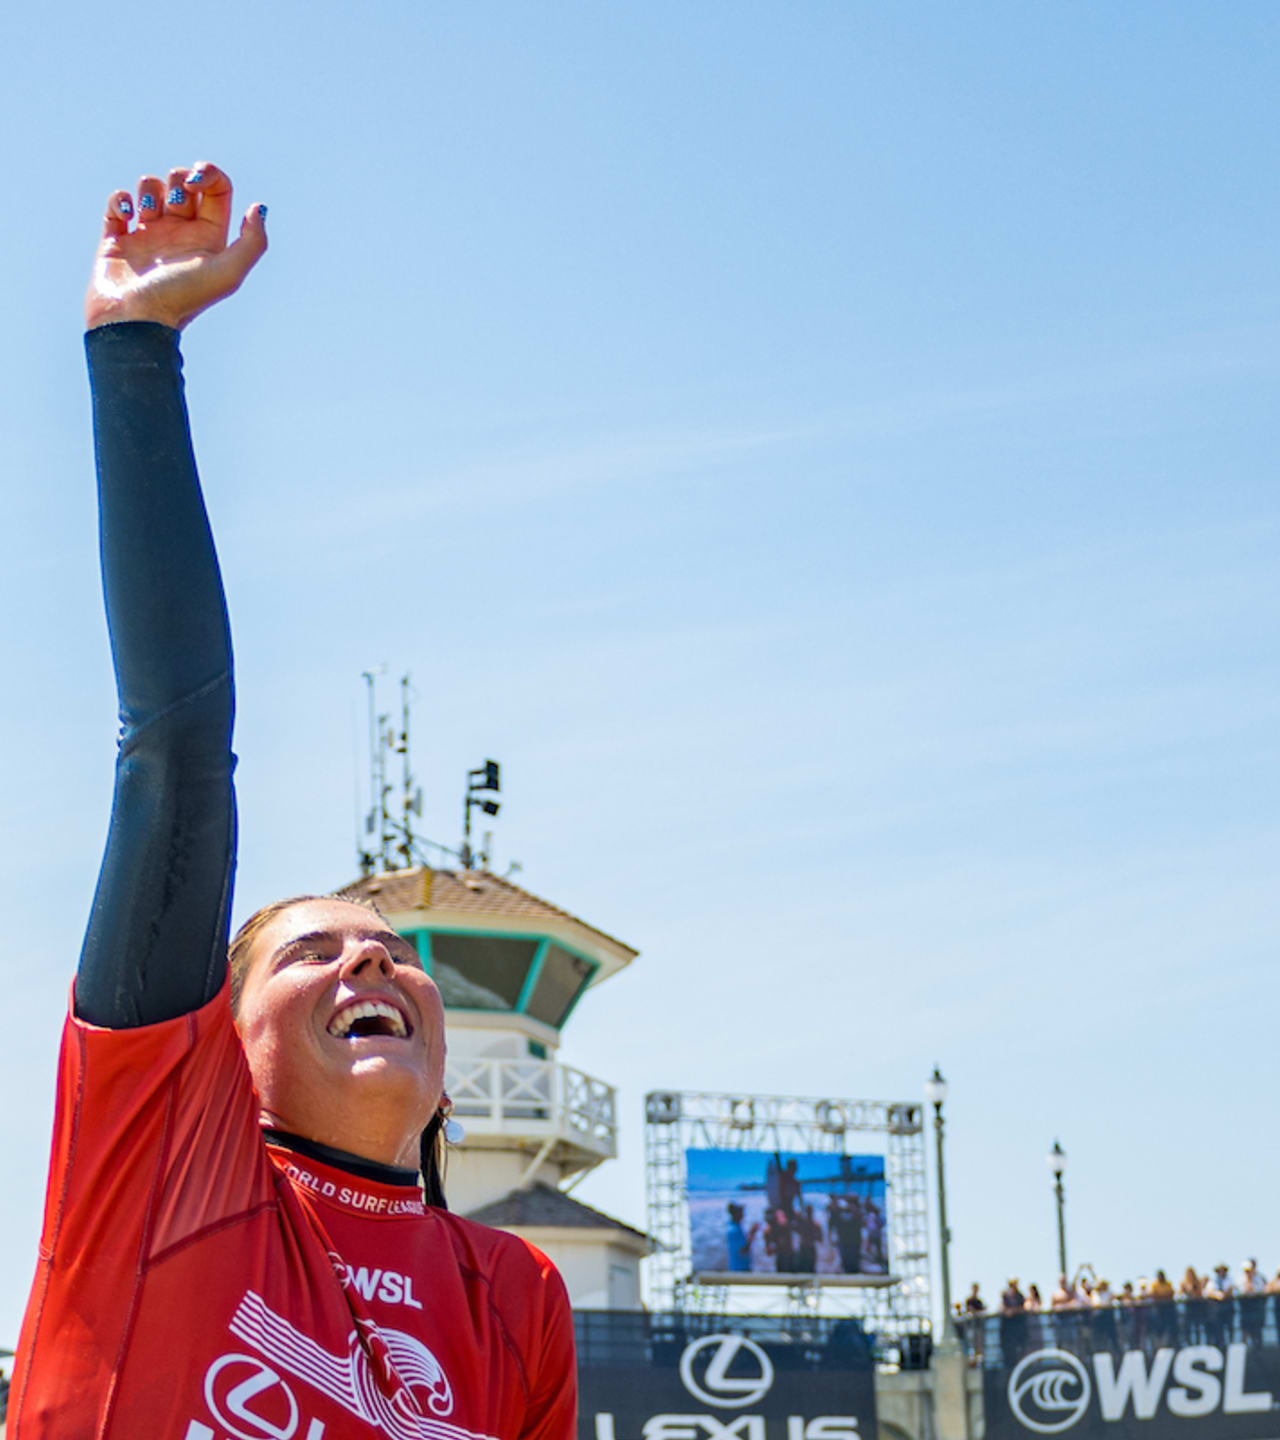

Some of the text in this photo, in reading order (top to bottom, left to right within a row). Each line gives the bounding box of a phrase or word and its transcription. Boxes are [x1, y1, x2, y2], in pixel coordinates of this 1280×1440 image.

[284, 1162, 336, 1197] ORLD
[338, 1188, 387, 1213] SURF
[345, 1264, 423, 1310] WSL
[1092, 1342, 1274, 1422] WSL
